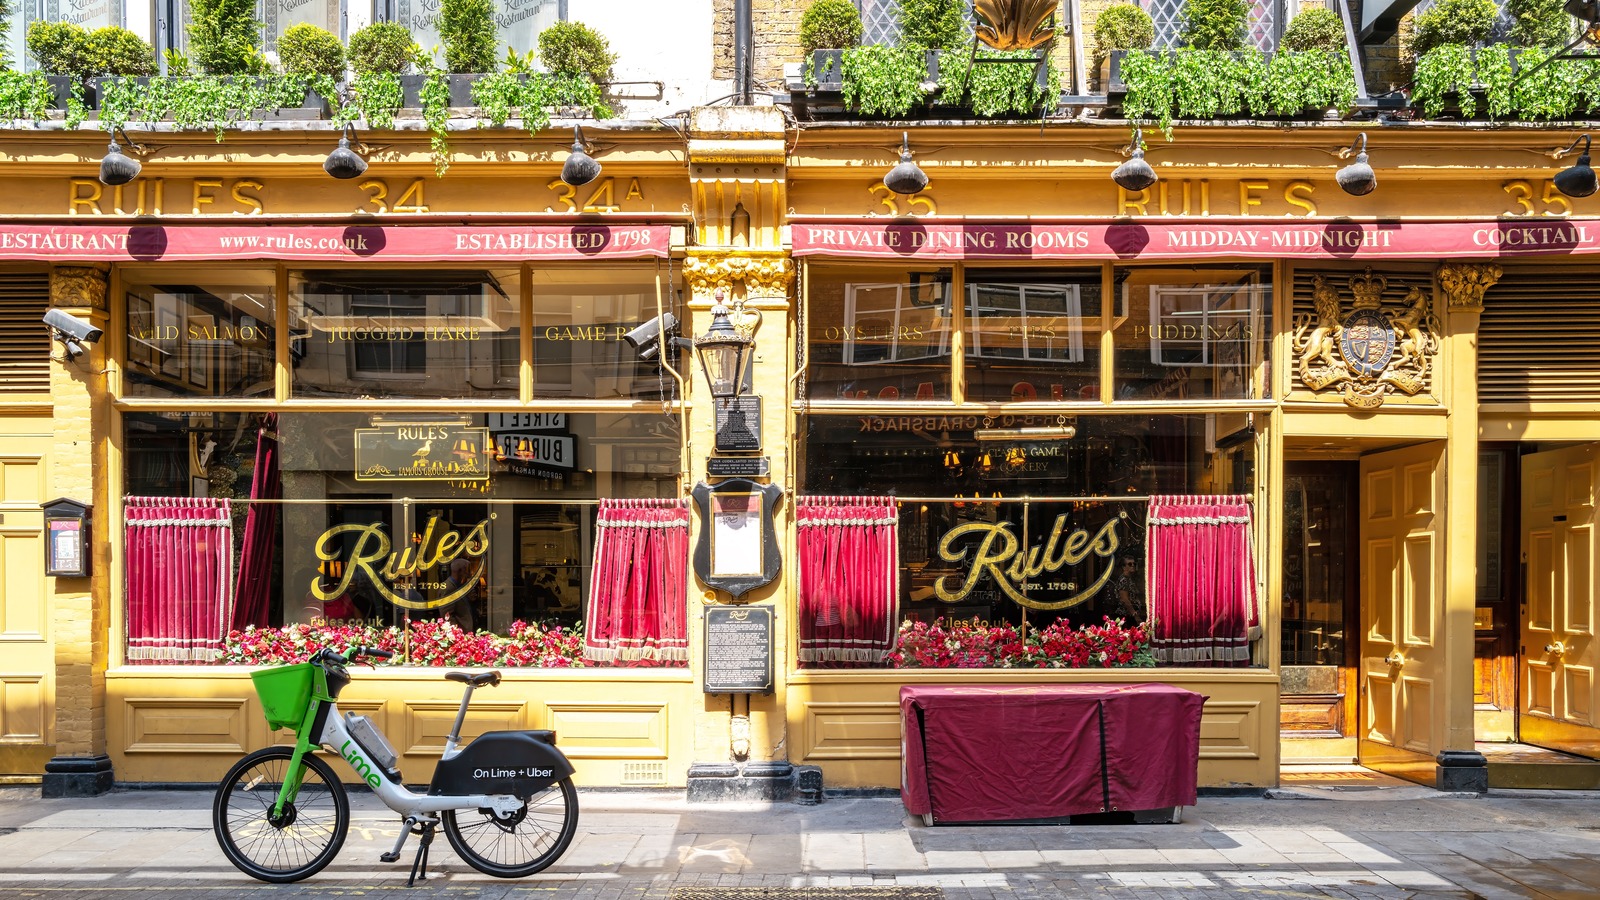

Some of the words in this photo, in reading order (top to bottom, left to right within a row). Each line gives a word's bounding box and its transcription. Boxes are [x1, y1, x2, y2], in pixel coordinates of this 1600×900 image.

[68, 177, 264, 215] RULES
[354, 177, 430, 213] 34
[867, 180, 938, 216] 35
[1118, 178, 1318, 216] RULES
[1502, 179, 1574, 216] 35
[219, 233, 369, 251] www.rules.co.uk
[455, 232, 605, 250] ESTABLISHED
[613, 229, 651, 247] 1798
[807, 228, 902, 247] PRIVATE
[910, 230, 996, 248] DINING
[1005, 231, 1089, 249] ROOMS
[1167, 229, 1394, 248] MIDDAY-MIDNIGHT
[1472, 225, 1594, 247] COCKTAIL
[188, 325, 269, 341] SALMON
[328, 326, 414, 344] JUGGED
[424, 326, 481, 341] HARE
[545, 326, 606, 341] GAME
[825, 325, 924, 341] OYSTERS
[1007, 325, 1057, 340] PIES
[1133, 324, 1254, 340] PUDDINGS
[397, 426, 449, 440] RULE'S
[310, 516, 490, 611] Rules
[933, 512, 1120, 611] Rules
[393, 582, 417, 590] EST.
[419, 582, 447, 590] 1798
[1020, 582, 1044, 591] EST.
[1046, 582, 1075, 591] 1798
[341, 740, 381, 789] Lime
[474, 768, 490, 779] On
[491, 768, 516, 778] Lime
[527, 767, 553, 777] Uber
